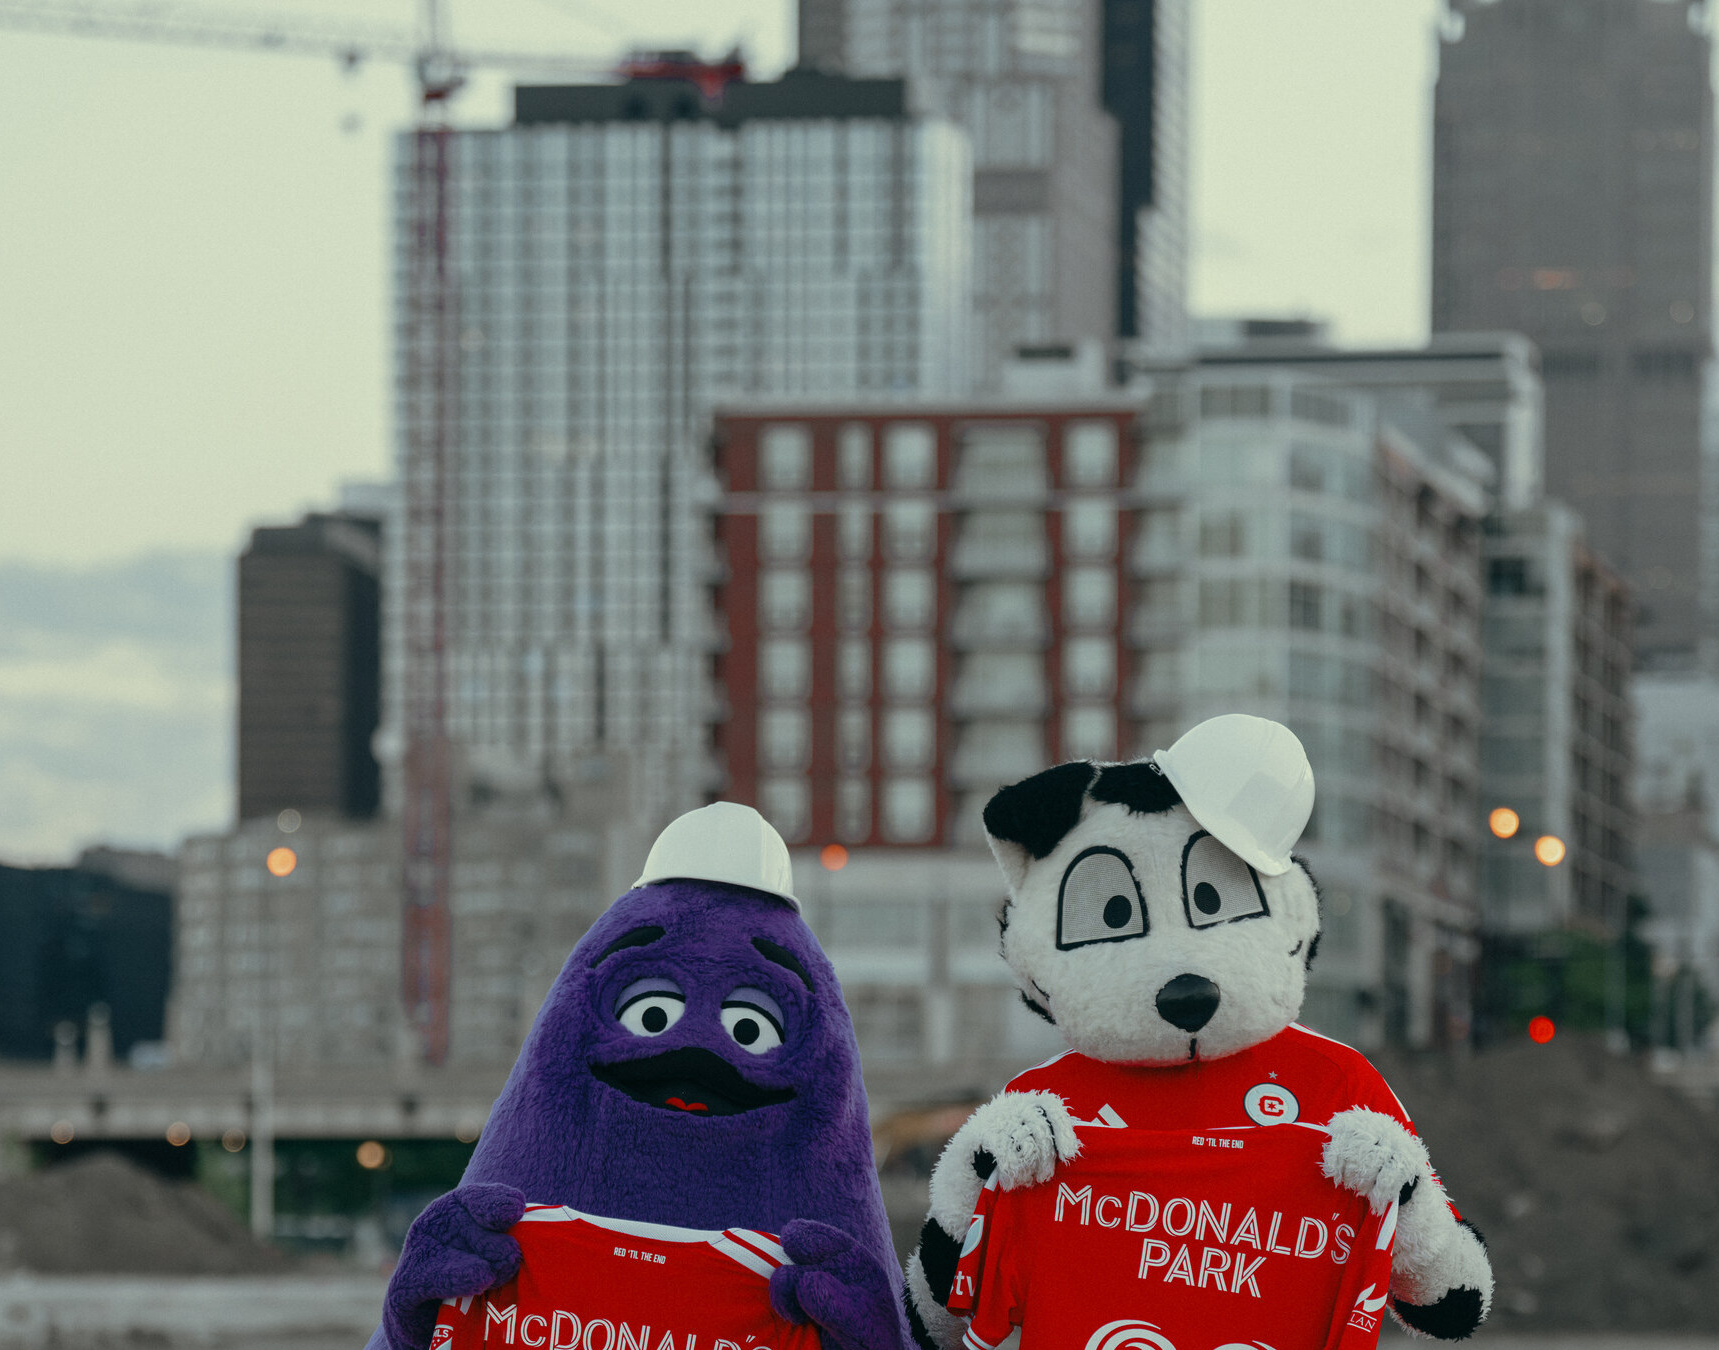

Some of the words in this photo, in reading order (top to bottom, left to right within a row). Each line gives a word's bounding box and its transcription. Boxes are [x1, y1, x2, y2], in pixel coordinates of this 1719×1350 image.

[1192, 1136, 1205, 1146] RED
[1219, 1138, 1231, 1148] THE
[1231, 1140, 1244, 1149] END
[1054, 1182, 1356, 1265] McDONALD'S
[613, 1246, 627, 1257] RED
[641, 1251, 654, 1262] THE
[653, 1254, 667, 1265] END
[1137, 1237, 1268, 1299] PARK
